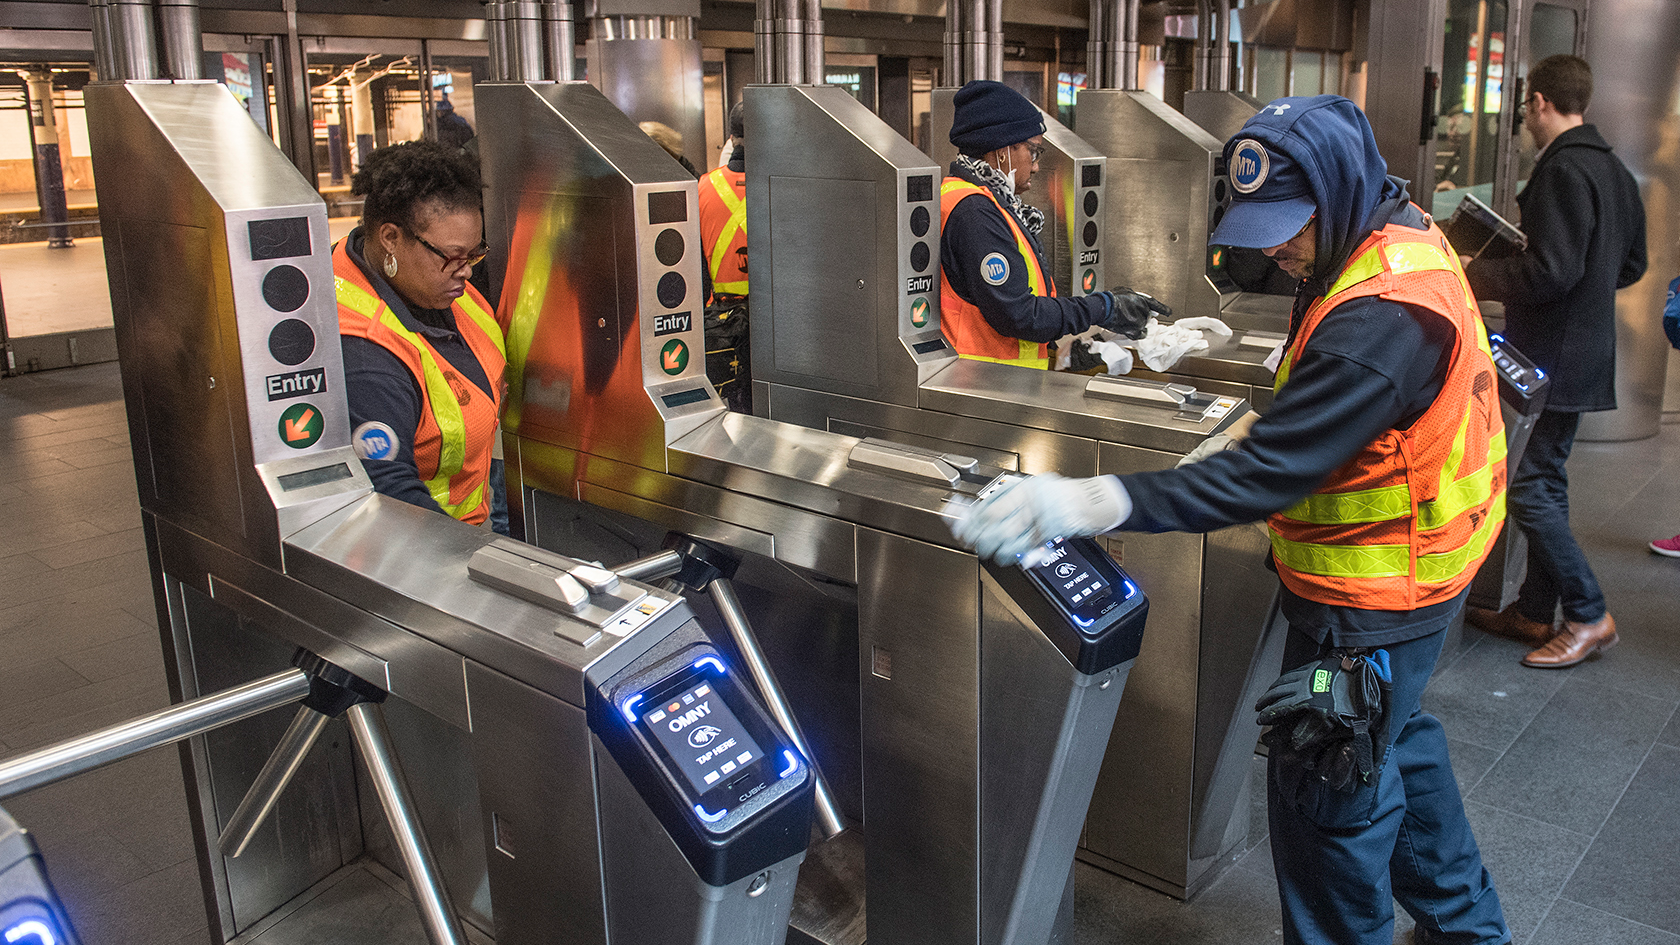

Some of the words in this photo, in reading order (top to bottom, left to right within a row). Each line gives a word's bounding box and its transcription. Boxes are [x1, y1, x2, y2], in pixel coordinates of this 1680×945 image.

[1236, 155, 1256, 176] MTA
[1080, 251, 1098, 264] Entry
[984, 263, 1004, 278] MTA
[907, 277, 932, 292] Entry
[654, 315, 690, 332] Entry
[267, 373, 323, 395] Entry
[1063, 579, 1076, 590] TAP
[1073, 571, 1090, 585] HERE
[1100, 601, 1119, 615] CUBIC
[668, 700, 711, 733] OMNY
[695, 750, 713, 765] TAP
[711, 737, 737, 756] HERE
[739, 782, 767, 802] CUBIC
